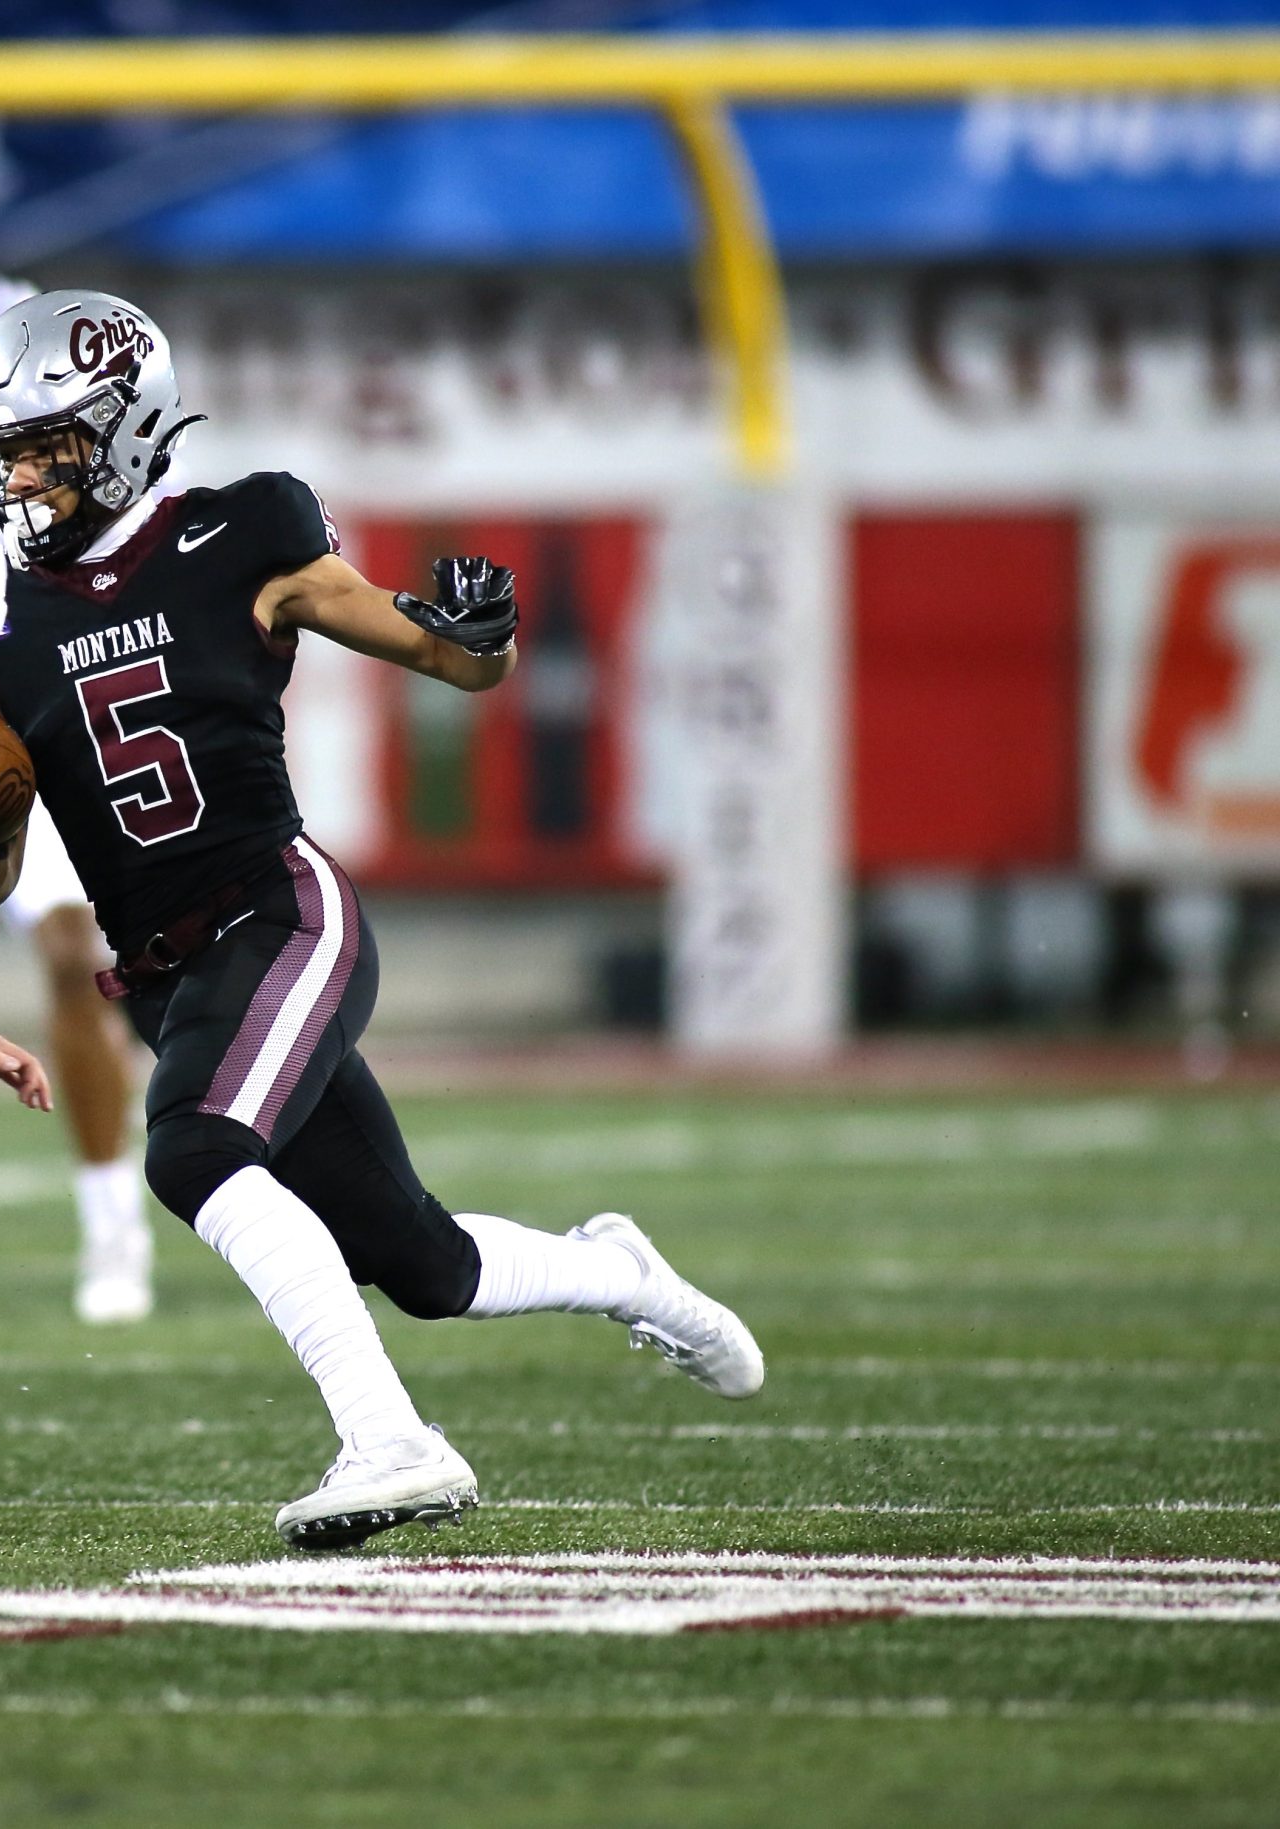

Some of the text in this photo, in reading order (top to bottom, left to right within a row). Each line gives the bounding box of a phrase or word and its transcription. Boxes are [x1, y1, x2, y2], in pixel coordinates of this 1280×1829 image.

[69, 311, 154, 375] Griz
[57, 612, 174, 675] MONTANA
[75, 655, 206, 847] 5
